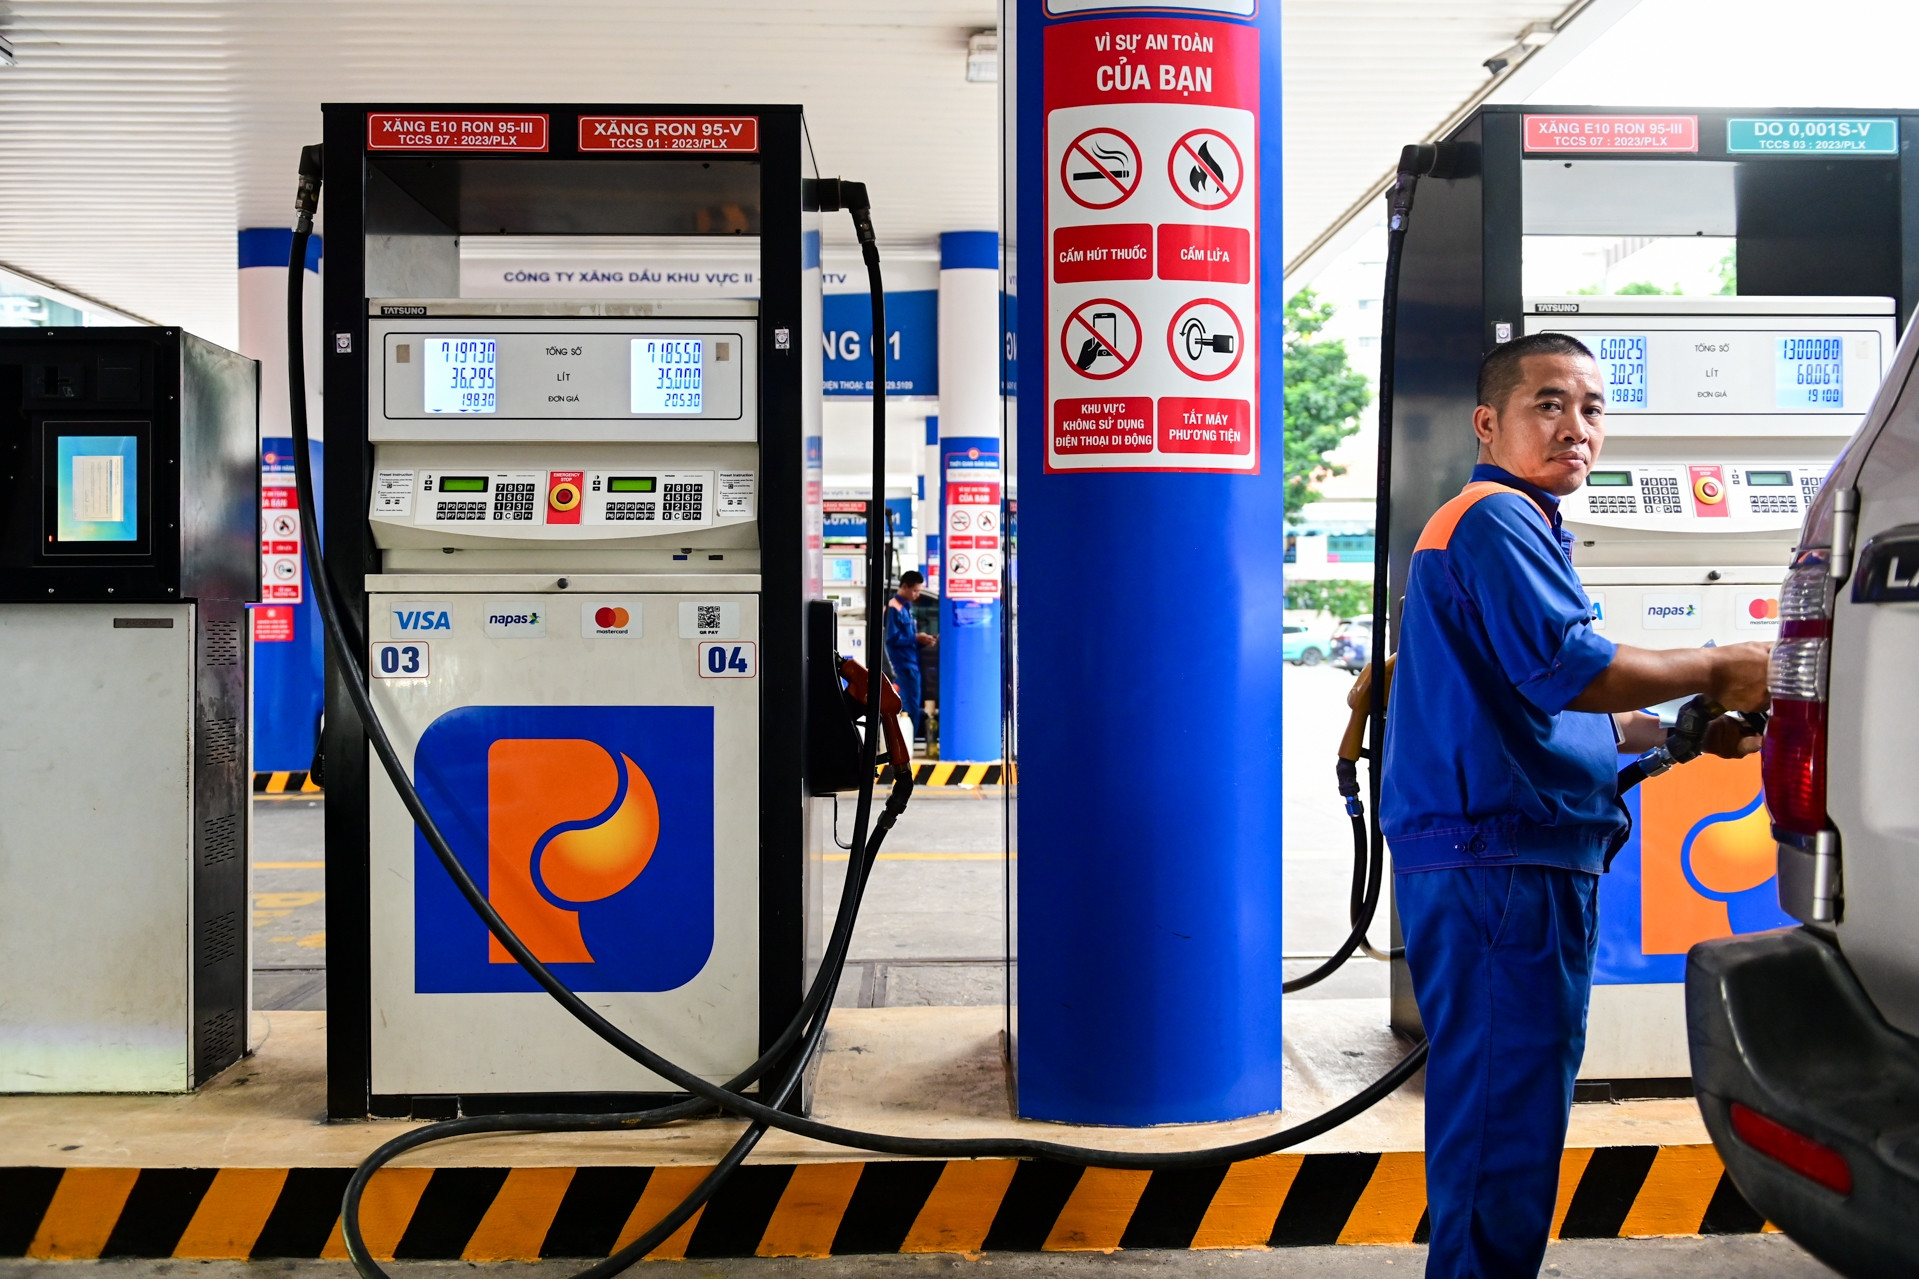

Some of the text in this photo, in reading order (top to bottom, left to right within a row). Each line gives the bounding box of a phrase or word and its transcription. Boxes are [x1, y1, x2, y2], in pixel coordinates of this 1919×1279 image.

[1095, 31, 1213, 54] VÌ SỰ AN TOÀN
[1096, 56, 1212, 96] CỦA BẠN
[382, 118, 533, 134] XĂNG E10 RON 95-III
[594, 120, 743, 137] XĂNG RON 95-V
[1539, 121, 1683, 135] XĂNG E10 RON 95-III
[1754, 122, 1871, 139] DO 0,001S-V
[398, 135, 433, 146] TCCS
[435, 135, 451, 146] 07
[461, 135, 518, 146] 2023/PLX
[609, 138, 643, 149] TCCS
[646, 138, 661, 149] 01
[672, 138, 728, 149] 2023/PLX
[1554, 136, 1586, 146] TCCS
[1589, 136, 1603, 146] 07
[1613, 136, 1668, 147] 2023/PLX
[1758, 140, 1791, 149] TCCS
[1793, 140, 1807, 149] 03
[1815, 140, 1866, 150] 2023/PLX
[1059, 244, 1147, 263] CẤM HÚT THUỐC
[1180, 245, 1230, 263] CẤM LỬA
[503, 271, 550, 283] CÔNG
[555, 272, 574, 283] TY
[579, 270, 624, 283] XĂNG
[667, 272, 700, 283] KHU
[706, 273, 739, 286] VỰC
[744, 273, 753, 283] II
[383, 306, 425, 316] TATSUNO
[1537, 304, 1578, 313] TATSUNO
[442, 341, 495, 363] 719730
[545, 345, 583, 356] TỔNG SỐ
[647, 342, 701, 364] 718550
[1600, 338, 1643, 360] 60025
[1694, 342, 1730, 353] TỔNG SỐ
[1783, 339, 1840, 360] 1300080
[556, 371, 571, 382] LÍT
[1705, 367, 1719, 378] LÍT
[462, 392, 495, 407] 19830
[548, 393, 580, 402] ĐƠN GIÁ
[664, 393, 700, 407] 20530
[1612, 388, 1643, 402] 19830
[1697, 389, 1728, 398] ĐƠN GIÁ
[1808, 388, 1840, 402] 19100
[1081, 403, 1126, 416] KHU VỰC
[1063, 417, 1145, 432] KHÔNG SỬ DỤNG
[1182, 409, 1229, 426] TẮT MÁY
[1055, 433, 1152, 449] ĐIỆN THOẠI DI ĐỘNG
[1169, 429, 1241, 444] PHƯƠNG TIỆN
[1886, 557, 1919, 588] L
[1647, 604, 1685, 618] napas
[392, 610, 451, 631] VISA
[489, 612, 528, 627] napas
[852, 639, 862, 647] 10
[380, 646, 420, 674] 03
[708, 646, 748, 674] 04
